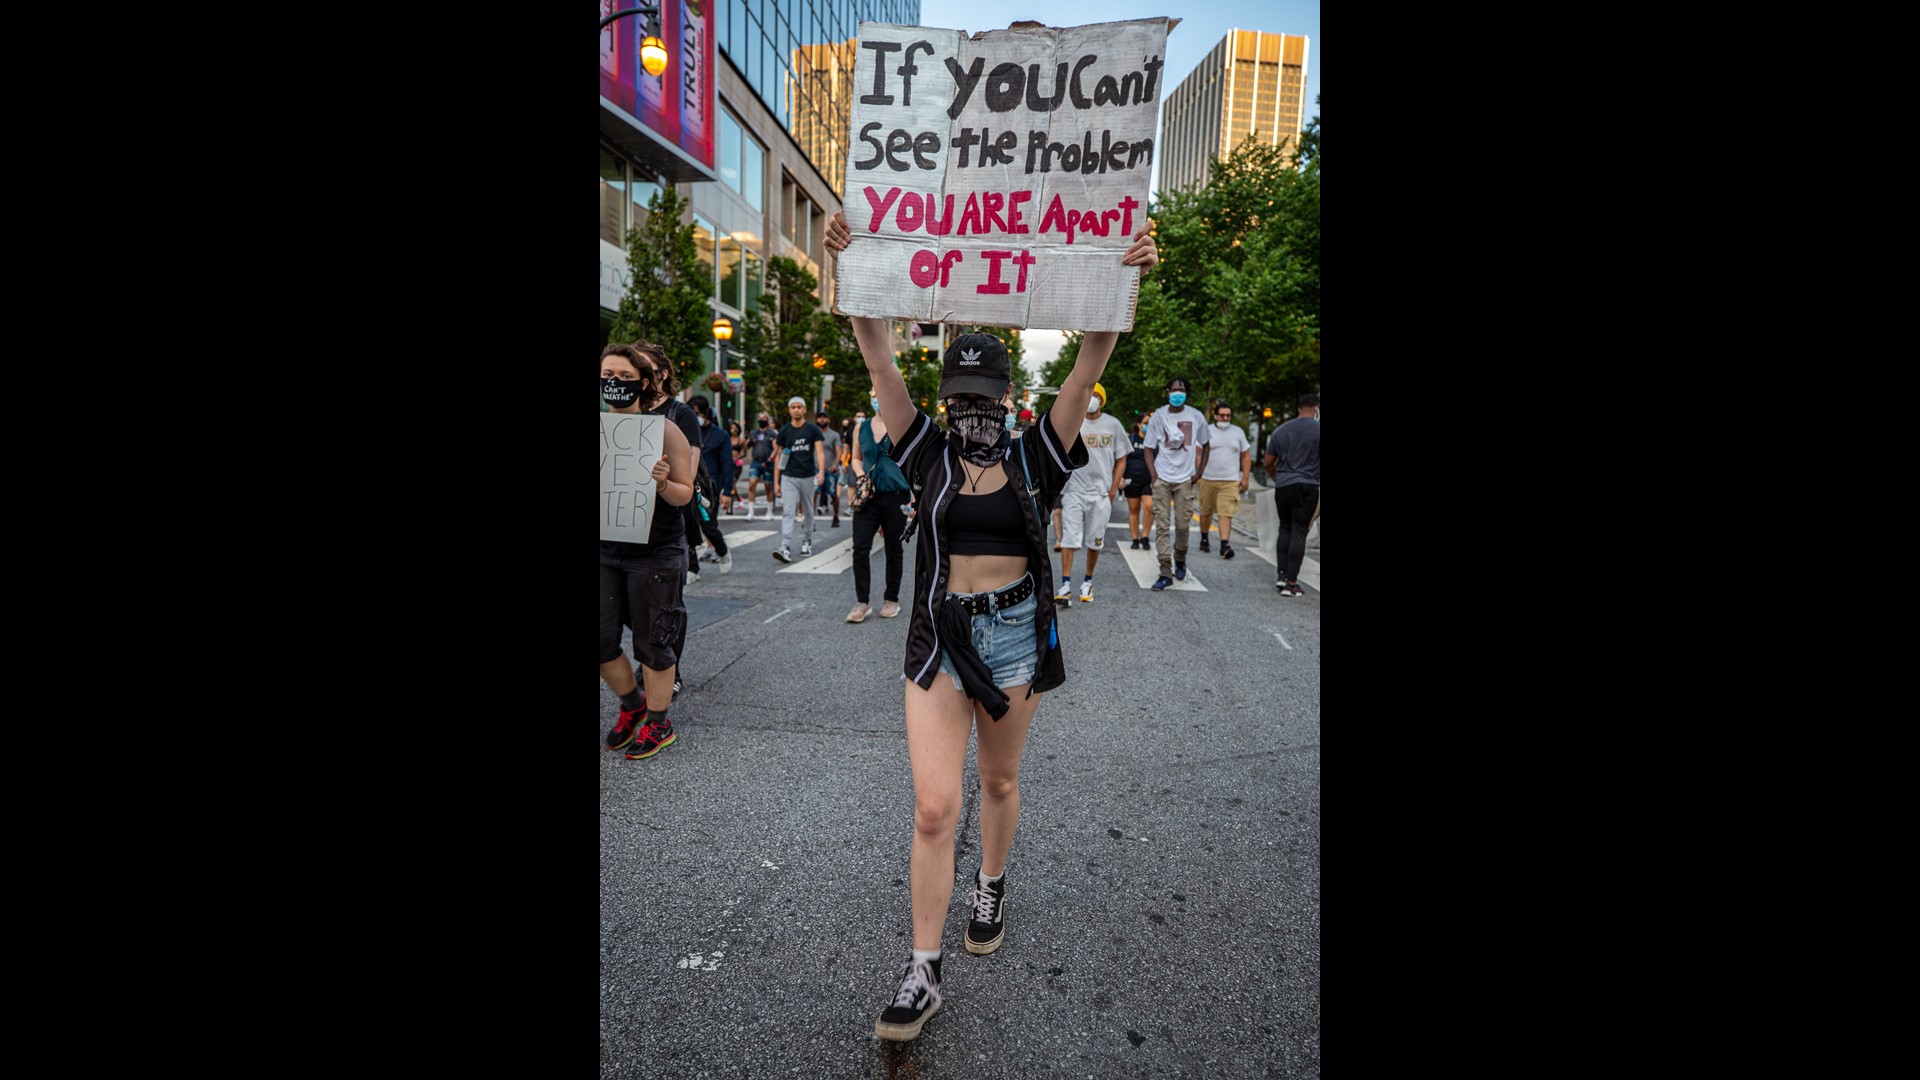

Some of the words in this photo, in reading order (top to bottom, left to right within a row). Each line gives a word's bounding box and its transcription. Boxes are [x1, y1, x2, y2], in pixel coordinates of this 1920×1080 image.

[684, 11, 696, 110] TRULY
[860, 40, 935, 107] If
[855, 121, 941, 172] See
[951, 127, 1018, 169] the
[863, 186, 954, 235] YOU
[956, 190, 1032, 236] ARE
[1038, 193, 1139, 245] Apart
[976, 249, 1036, 295] It
[604, 385, 627, 394] CAN'T
[603, 490, 648, 528] TER
